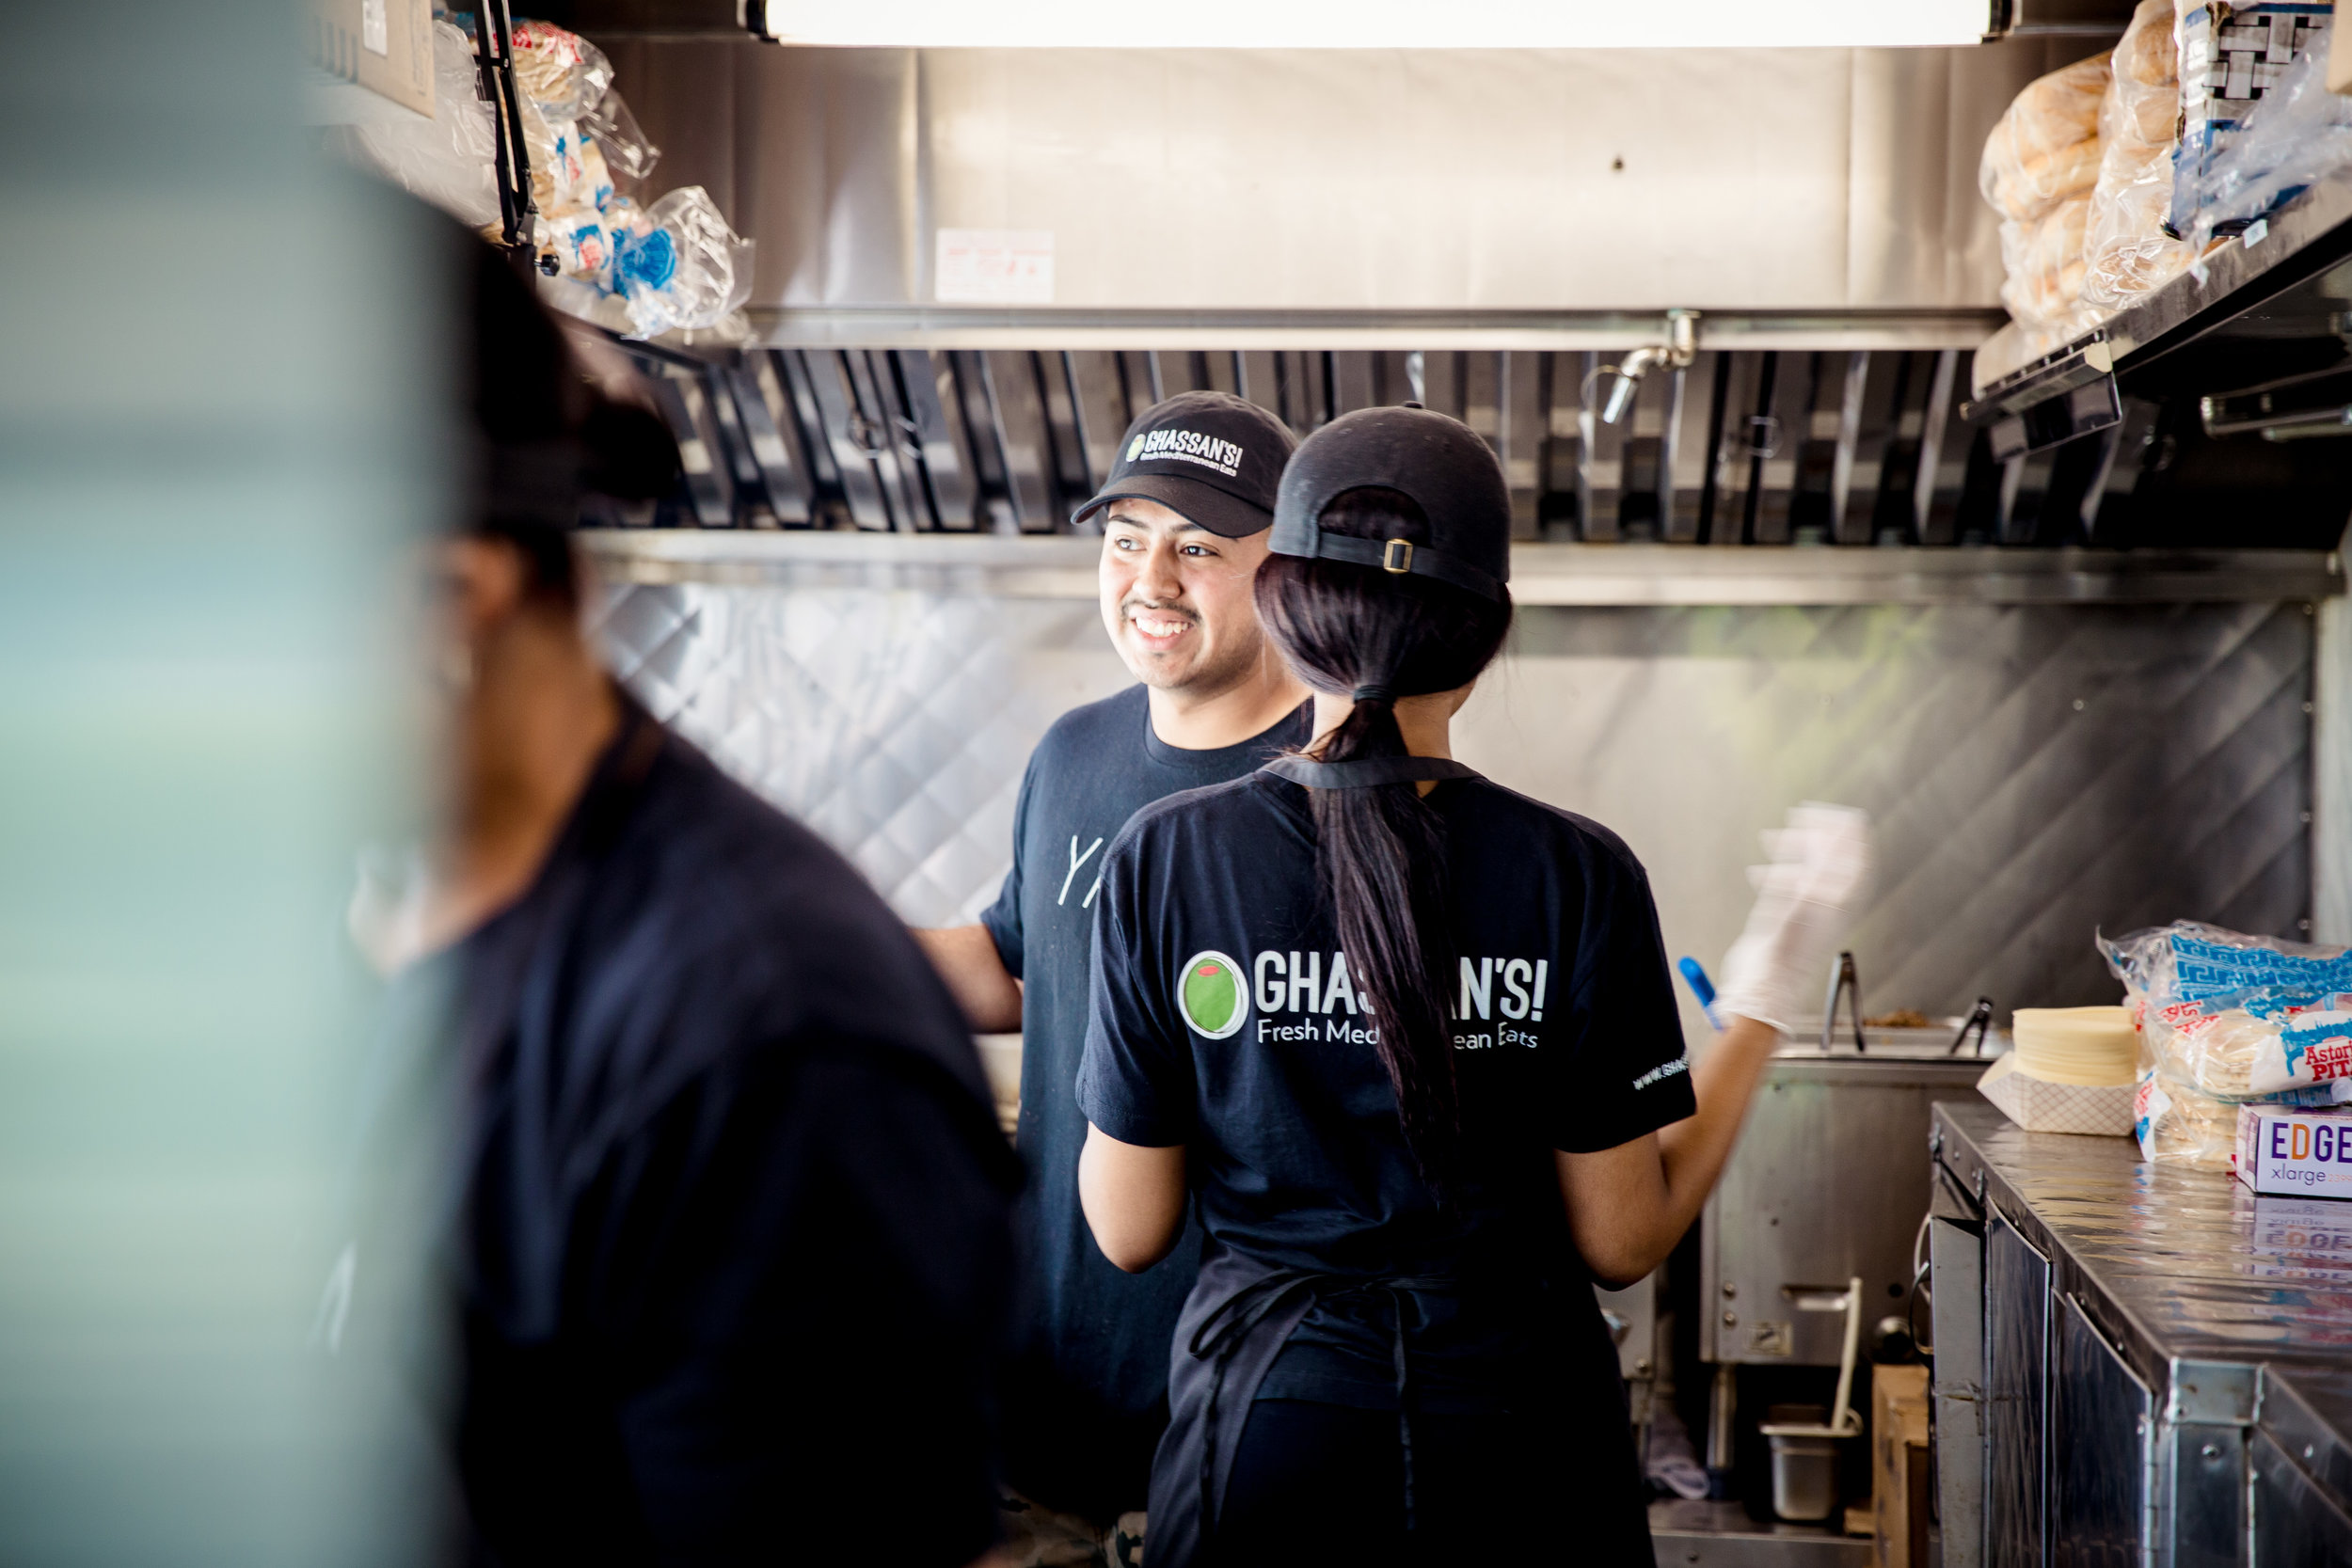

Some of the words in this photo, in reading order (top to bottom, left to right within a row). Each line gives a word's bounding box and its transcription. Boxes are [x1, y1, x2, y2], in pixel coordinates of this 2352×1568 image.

[1144, 429, 1243, 468] GHASSAN'S!
[1219, 464, 1237, 478] Eats
[1254, 950, 1549, 1022] GHAN'S!
[1257, 1018, 1319, 1043] Fresh
[1498, 1022, 1538, 1049] Eats
[2312, 1059, 2352, 1082] PIT
[2271, 1122, 2352, 1164] EDGE
[2271, 1163, 2327, 1186] xlarge
